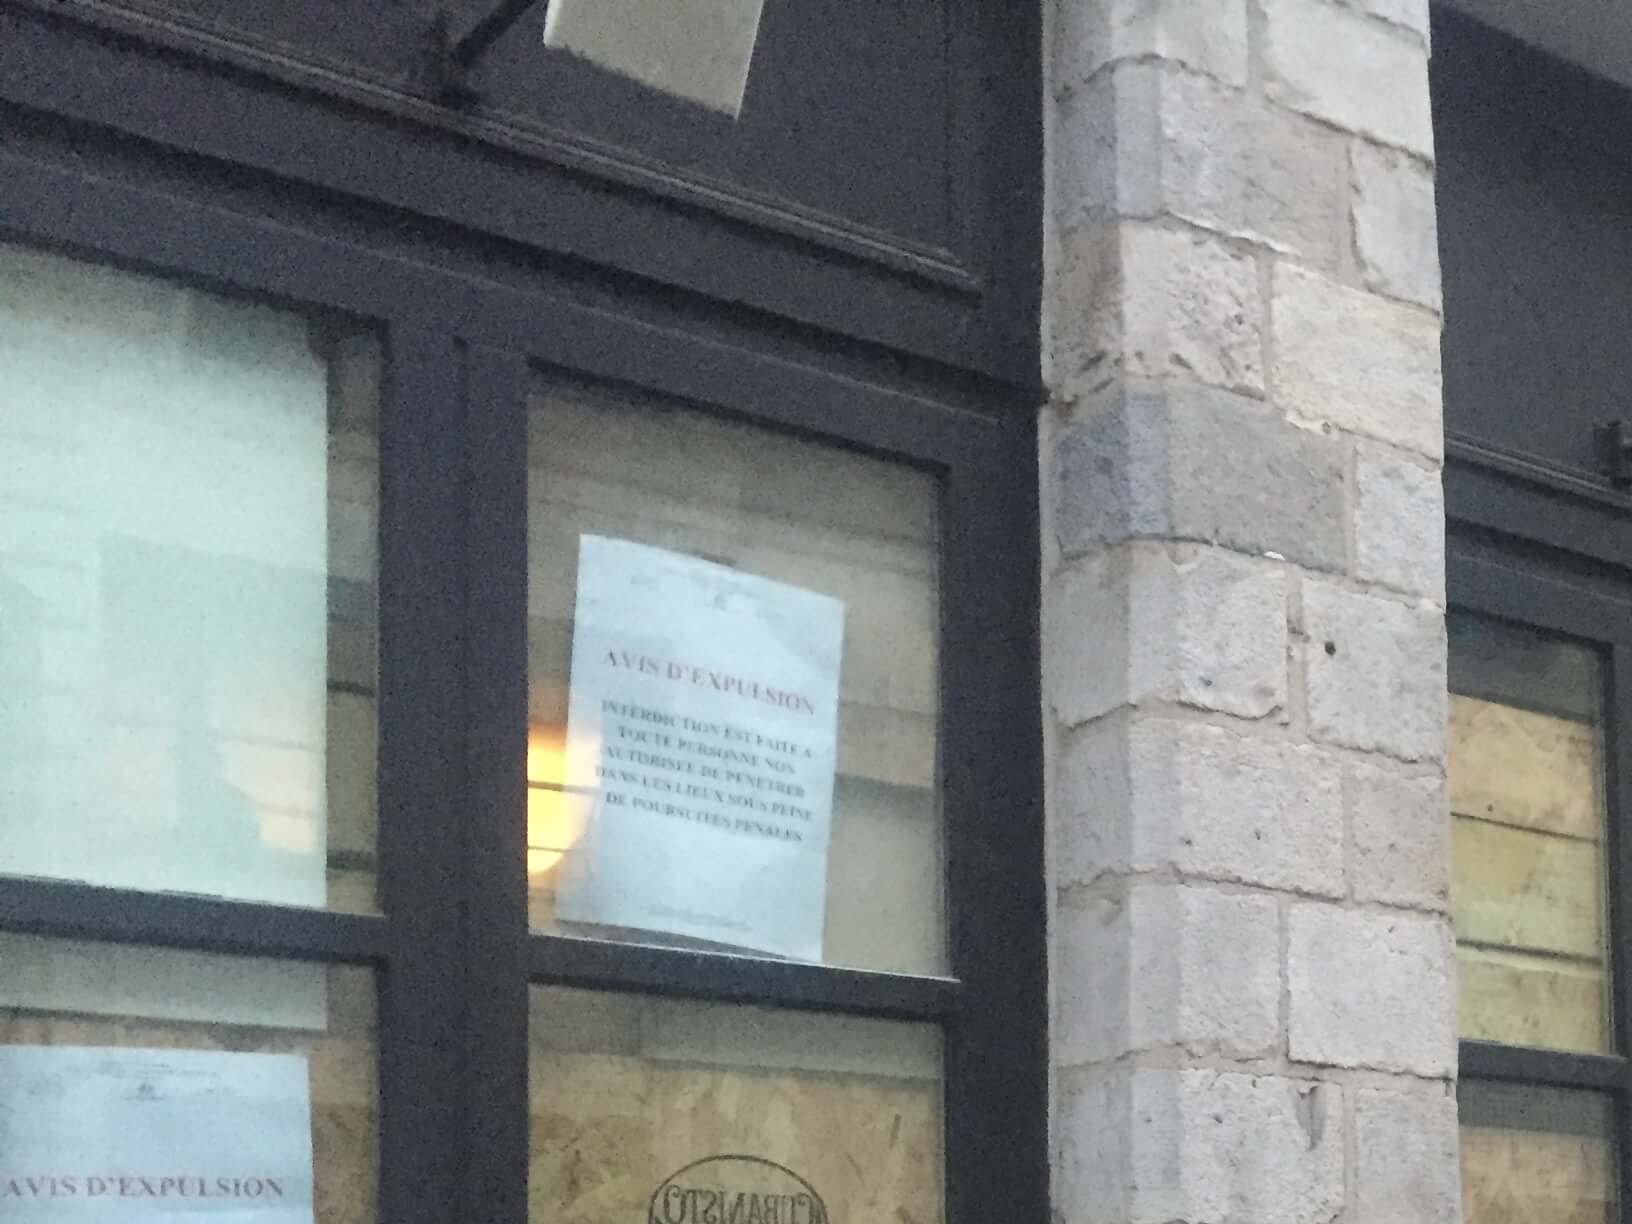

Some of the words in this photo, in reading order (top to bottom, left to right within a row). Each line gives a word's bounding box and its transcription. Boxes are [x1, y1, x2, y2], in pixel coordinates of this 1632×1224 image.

[605, 650, 659, 674] AVIS
[4, 1175, 79, 1199] AVIS
[86, 1175, 285, 1199] D'EXPULSION
